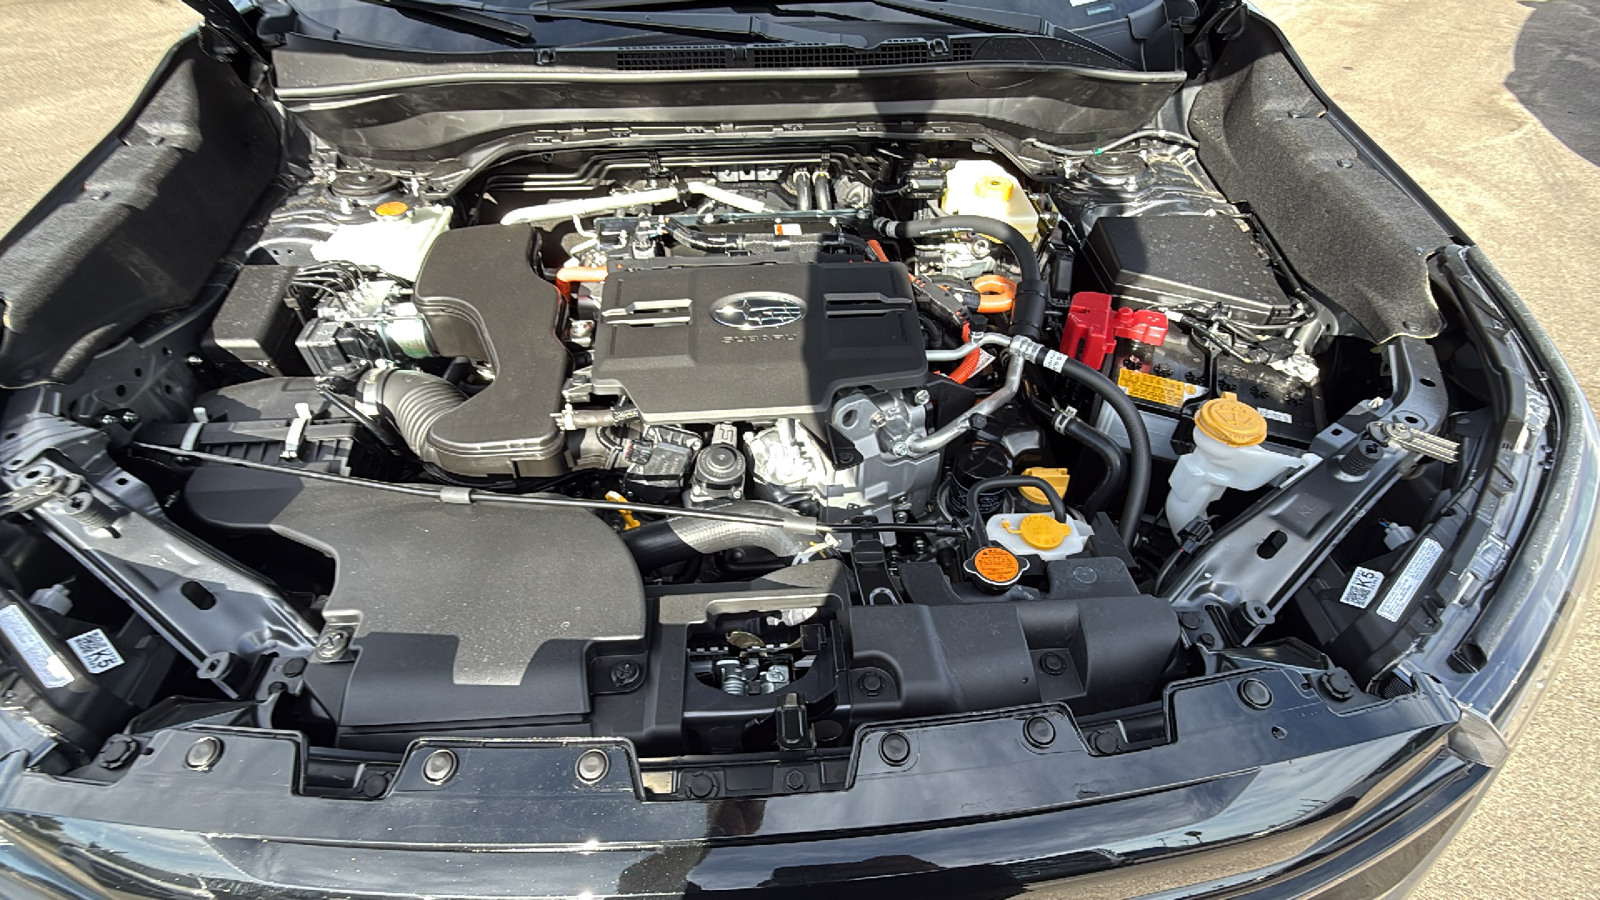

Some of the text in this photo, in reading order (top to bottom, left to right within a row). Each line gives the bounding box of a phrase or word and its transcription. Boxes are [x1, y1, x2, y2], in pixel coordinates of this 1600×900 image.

[722, 333, 797, 344] SUBARU
[1357, 571, 1375, 588] K5
[91, 649, 113, 669] K5
